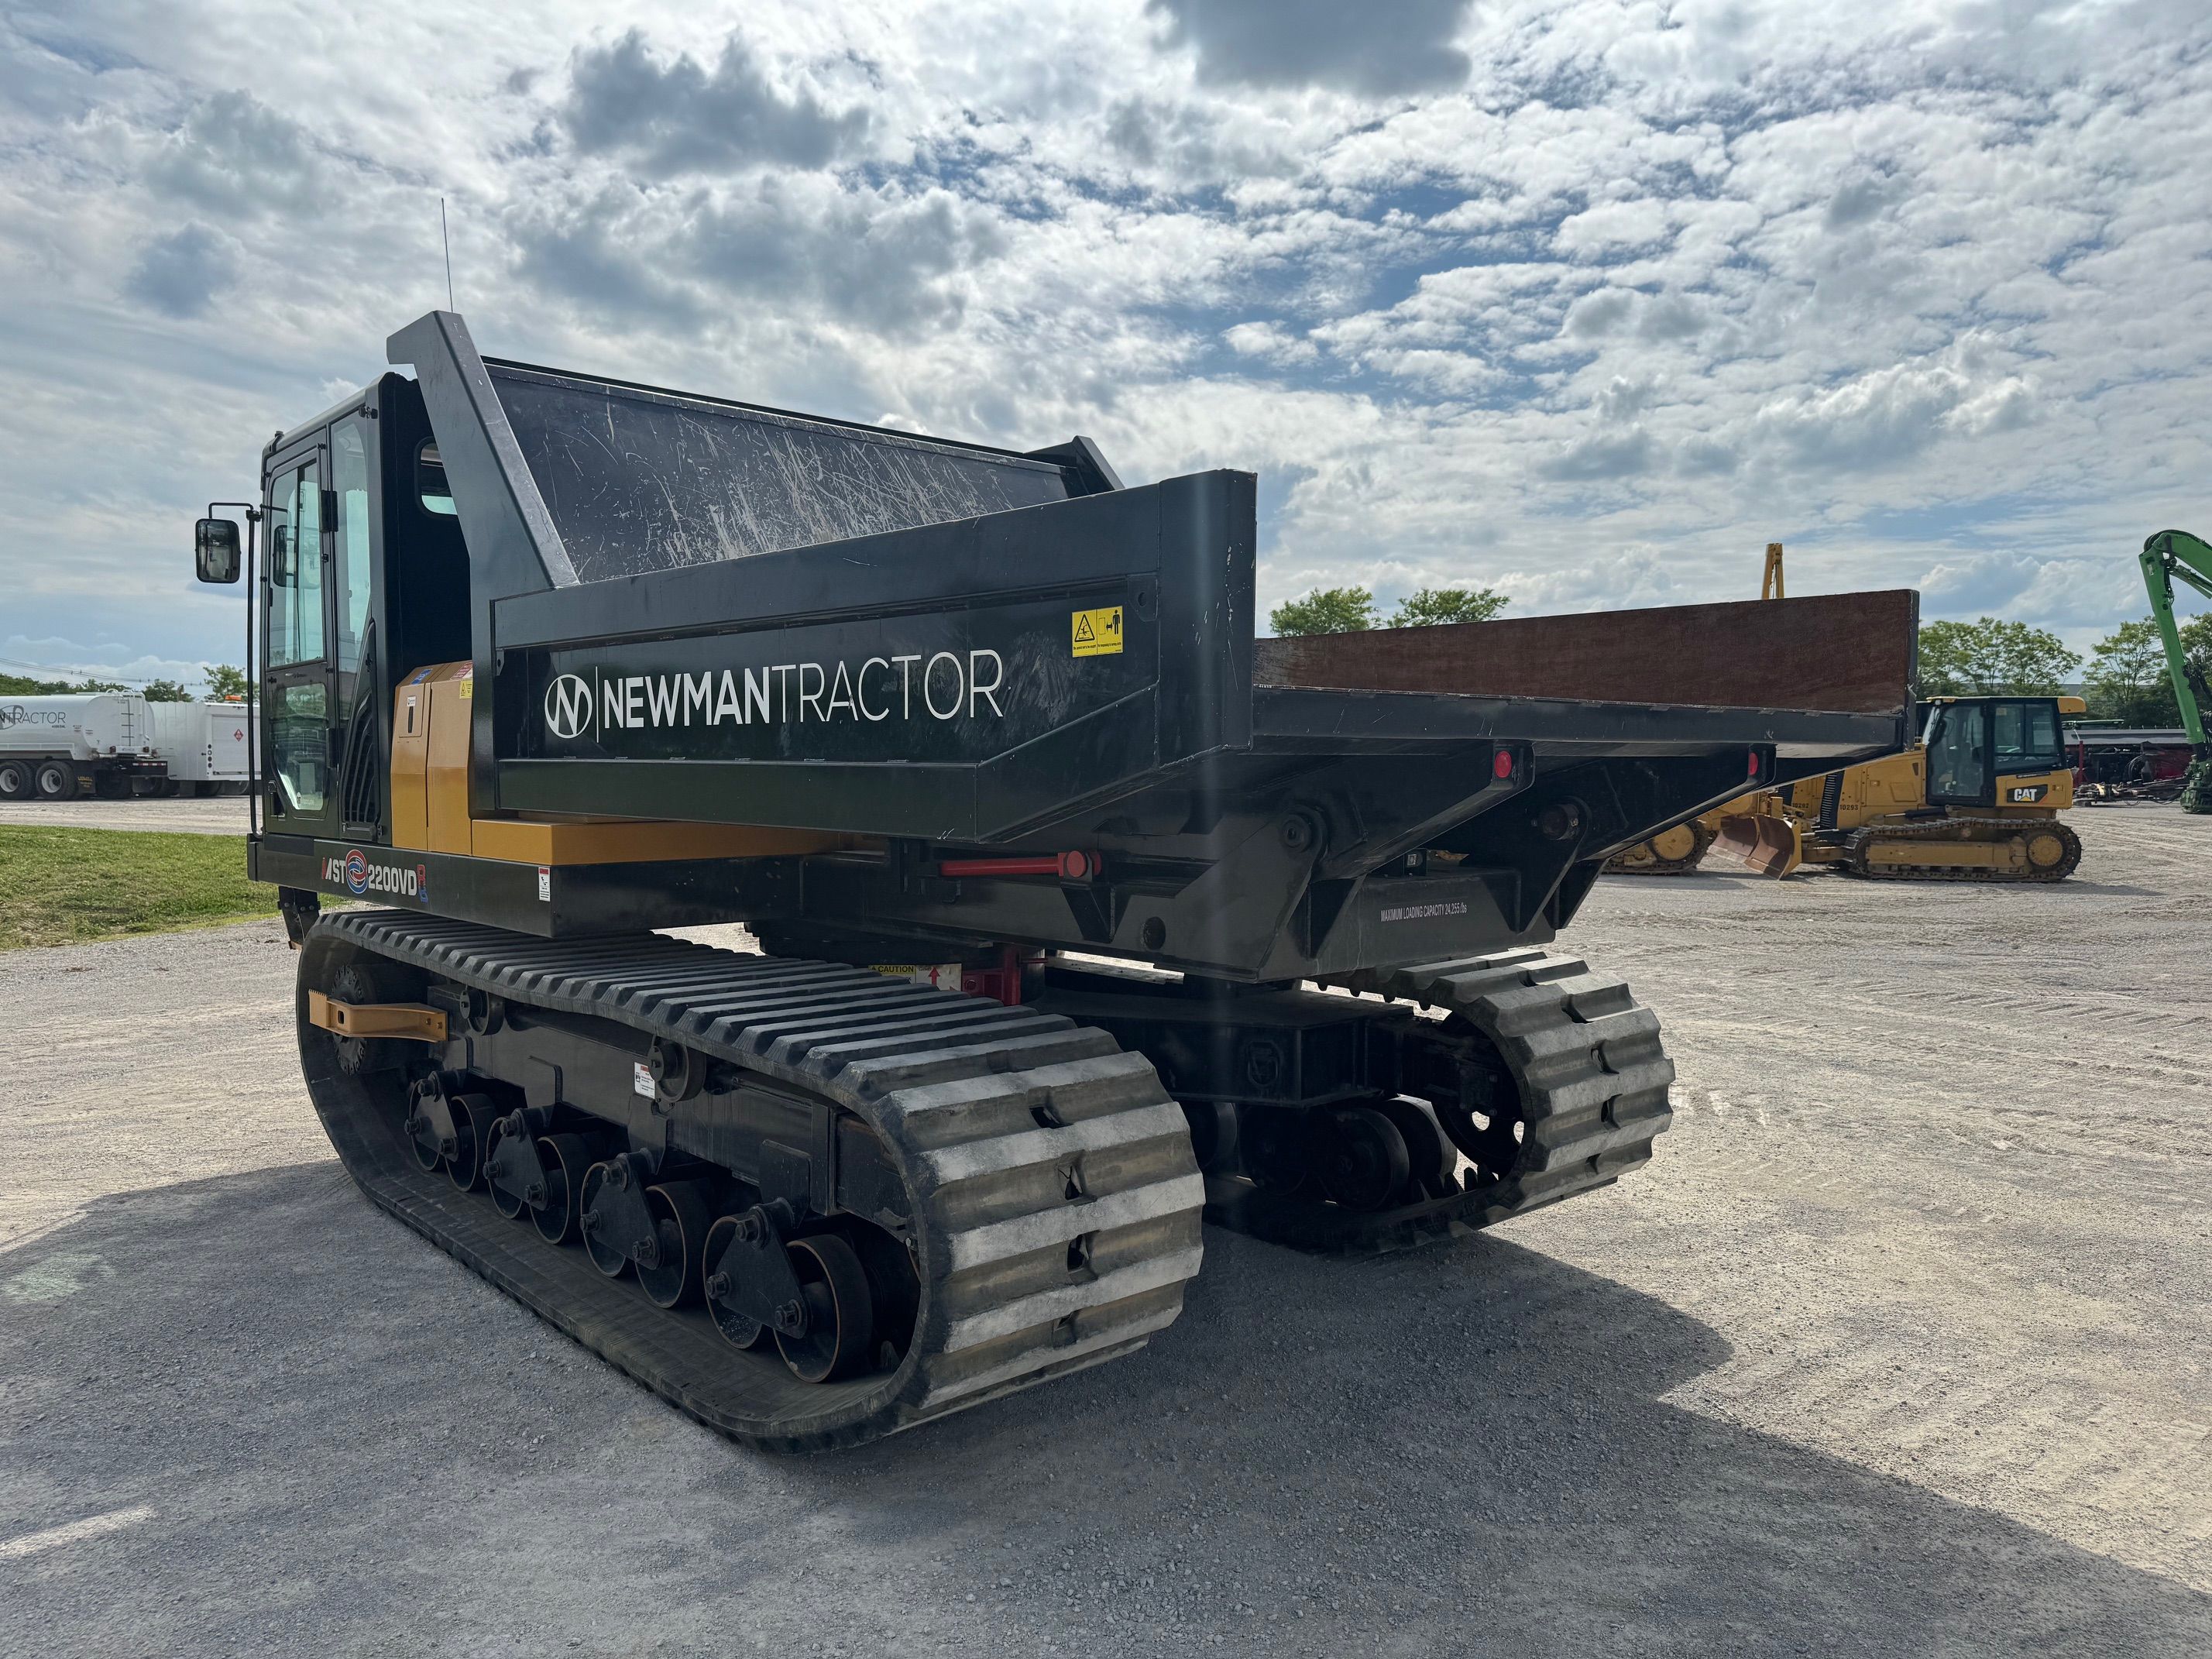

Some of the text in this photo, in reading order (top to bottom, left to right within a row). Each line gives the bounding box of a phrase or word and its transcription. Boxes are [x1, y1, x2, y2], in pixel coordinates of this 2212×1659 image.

[2014, 788, 2037, 802] CAT
[1381, 908, 1403, 922] MAXIMUM
[1403, 905, 1423, 919] LOADING
[1424, 904, 1445, 917] CAPACITY
[1445, 902, 1460, 915] 24,255
[878, 965, 914, 974] CAUTION
